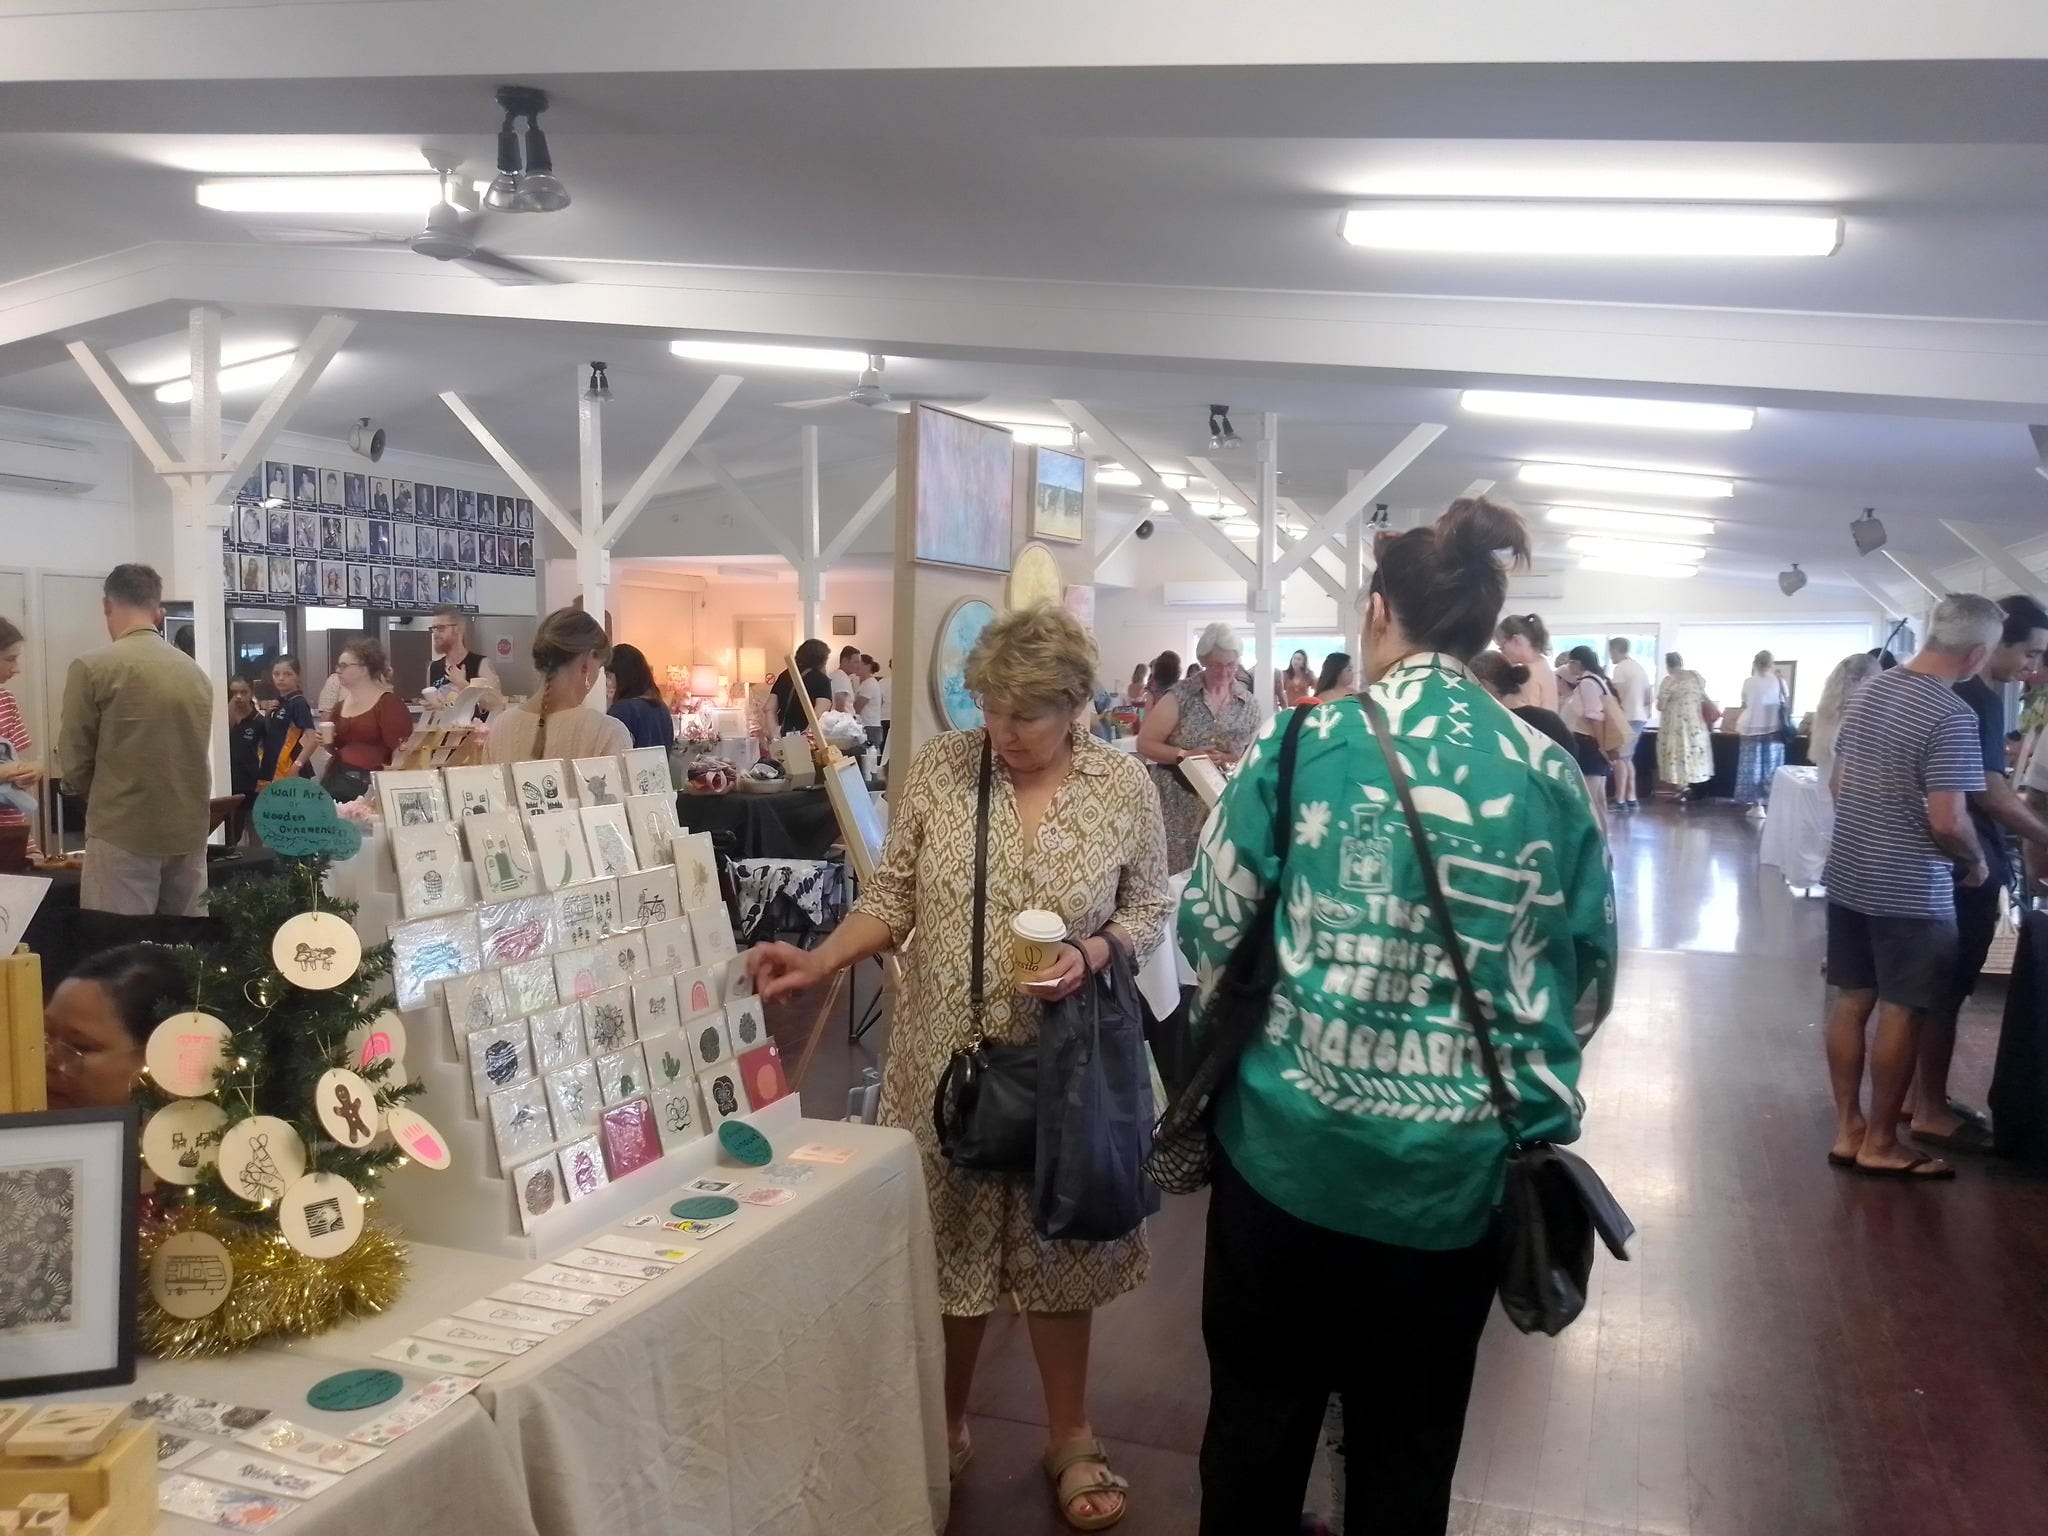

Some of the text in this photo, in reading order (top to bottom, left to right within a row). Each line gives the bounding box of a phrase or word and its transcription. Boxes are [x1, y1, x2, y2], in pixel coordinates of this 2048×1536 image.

[271, 787, 325, 800] Wall Art
[262, 811, 306, 821] Wooden
